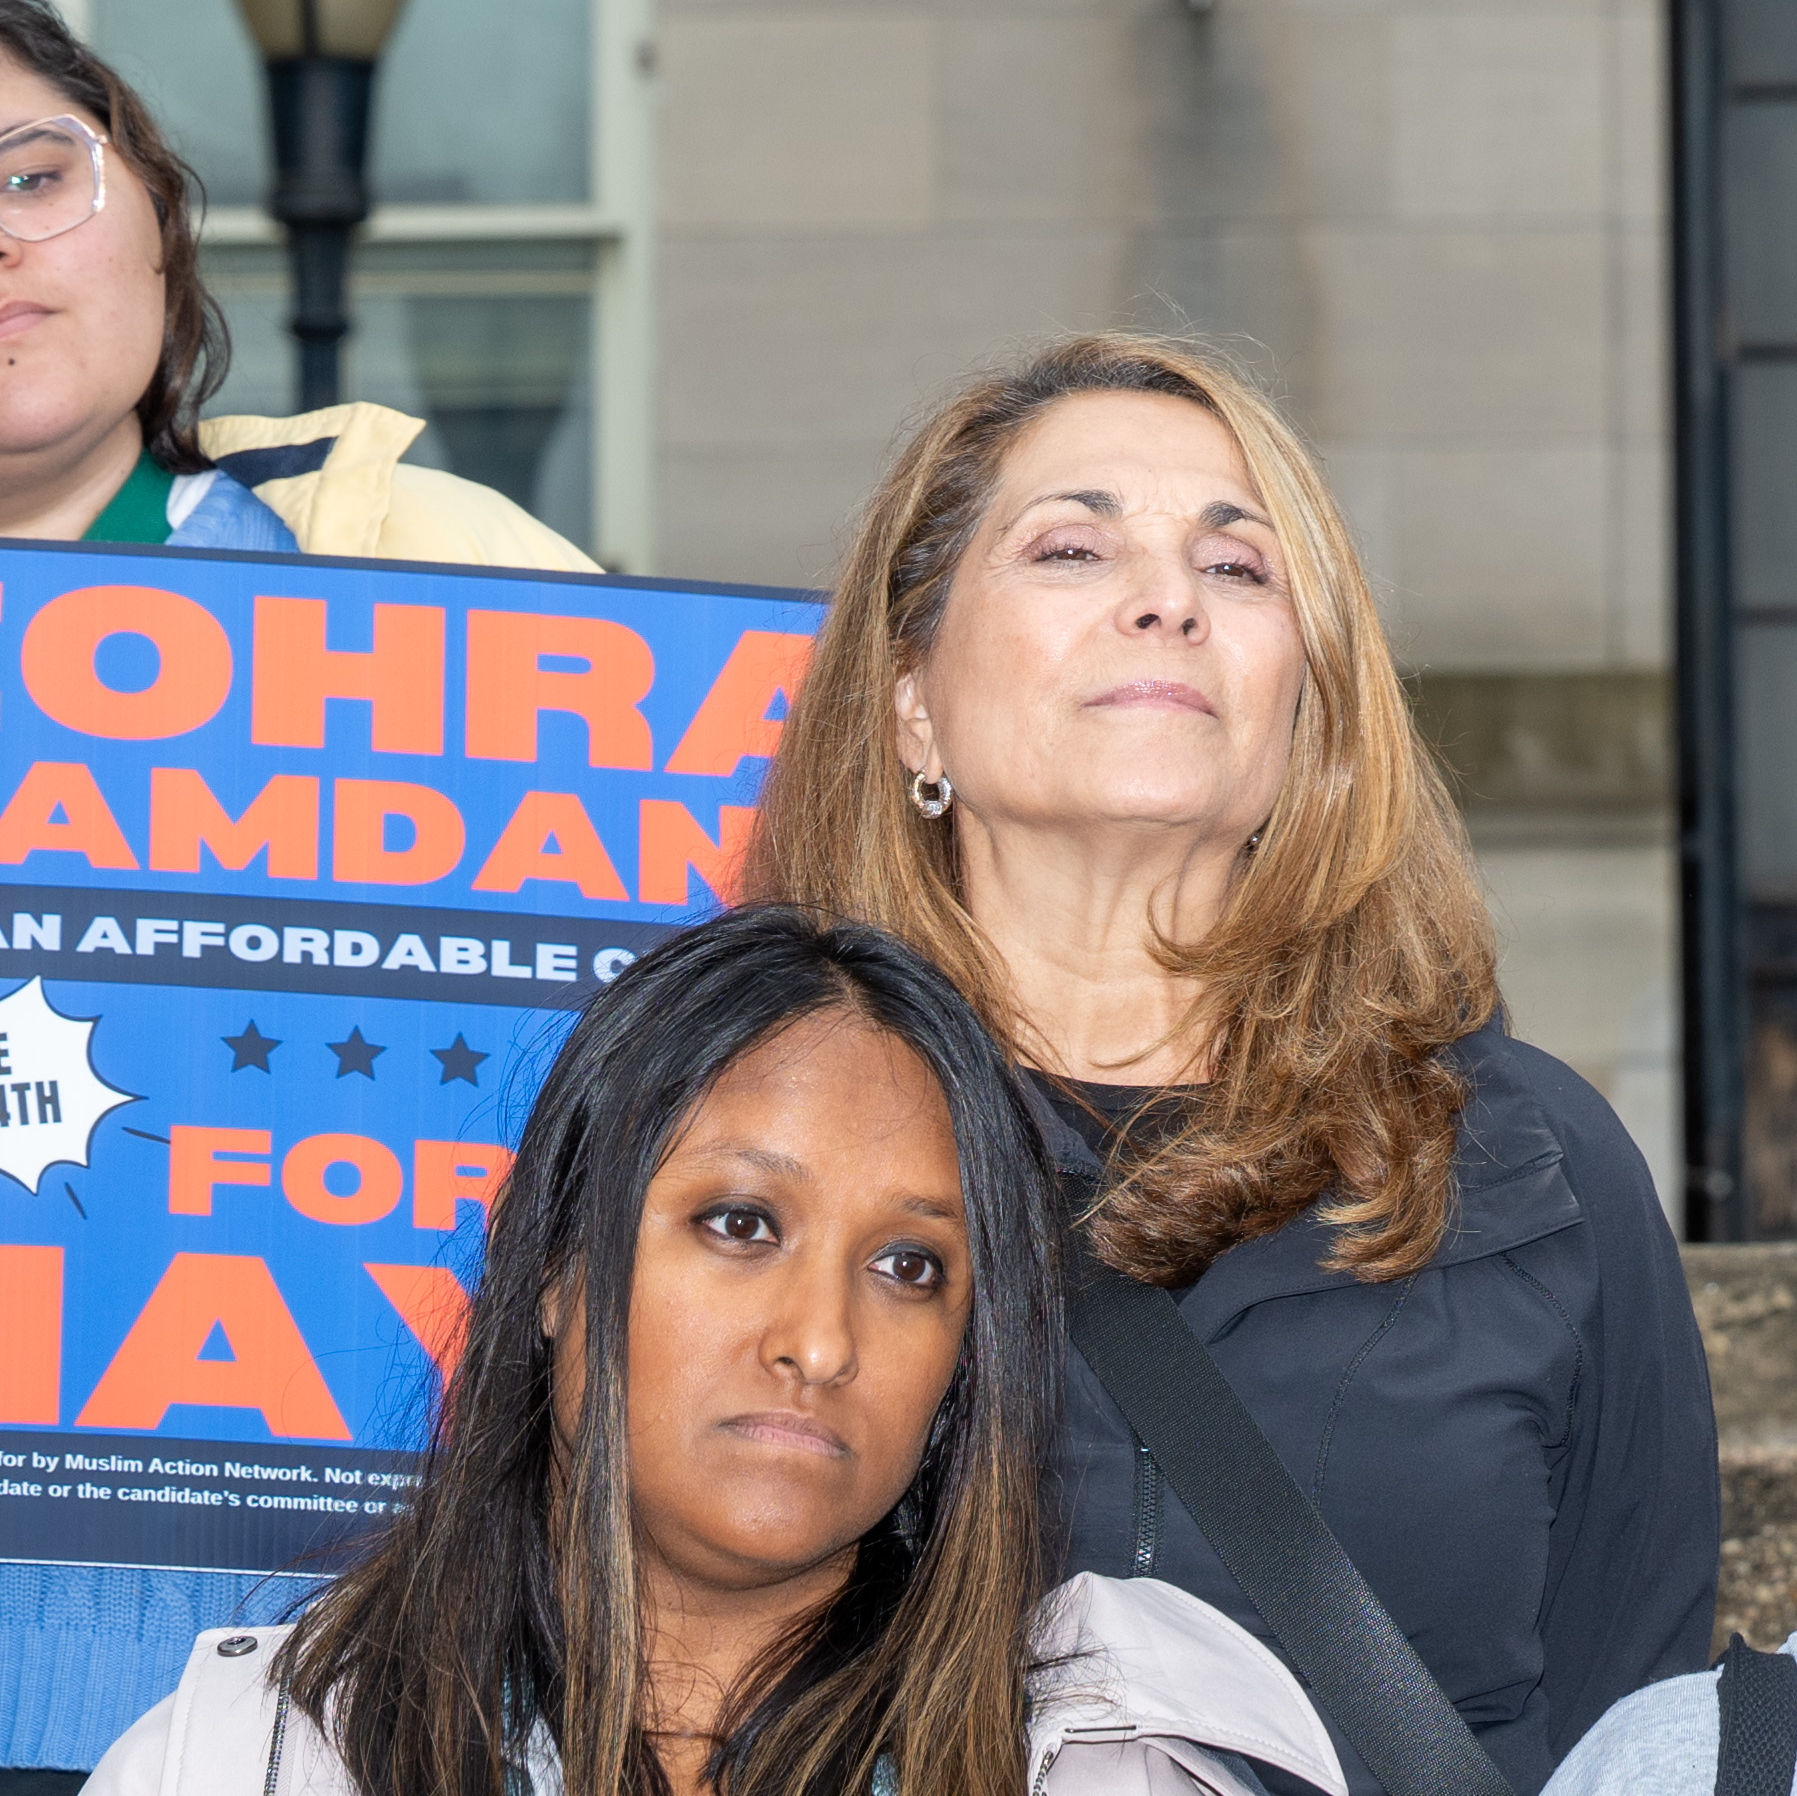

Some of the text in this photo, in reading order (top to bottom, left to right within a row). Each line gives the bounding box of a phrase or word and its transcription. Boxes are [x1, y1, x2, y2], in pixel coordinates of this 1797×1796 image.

[0, 583, 818, 777] OHRA
[75, 915, 578, 984] AFFORDABLE
[168, 1122, 519, 1232] FOR
[31, 1451, 60, 1473] by
[65, 1453, 143, 1473] Muslim
[148, 1457, 219, 1477] Action
[223, 1461, 319, 1483] Network.
[324, 1467, 363, 1485] Not
[48, 1483, 72, 1498] or
[77, 1482, 112, 1500] the
[117, 1486, 241, 1507] candidate's
[246, 1493, 358, 1513] committee
[364, 1500, 388, 1515] or
